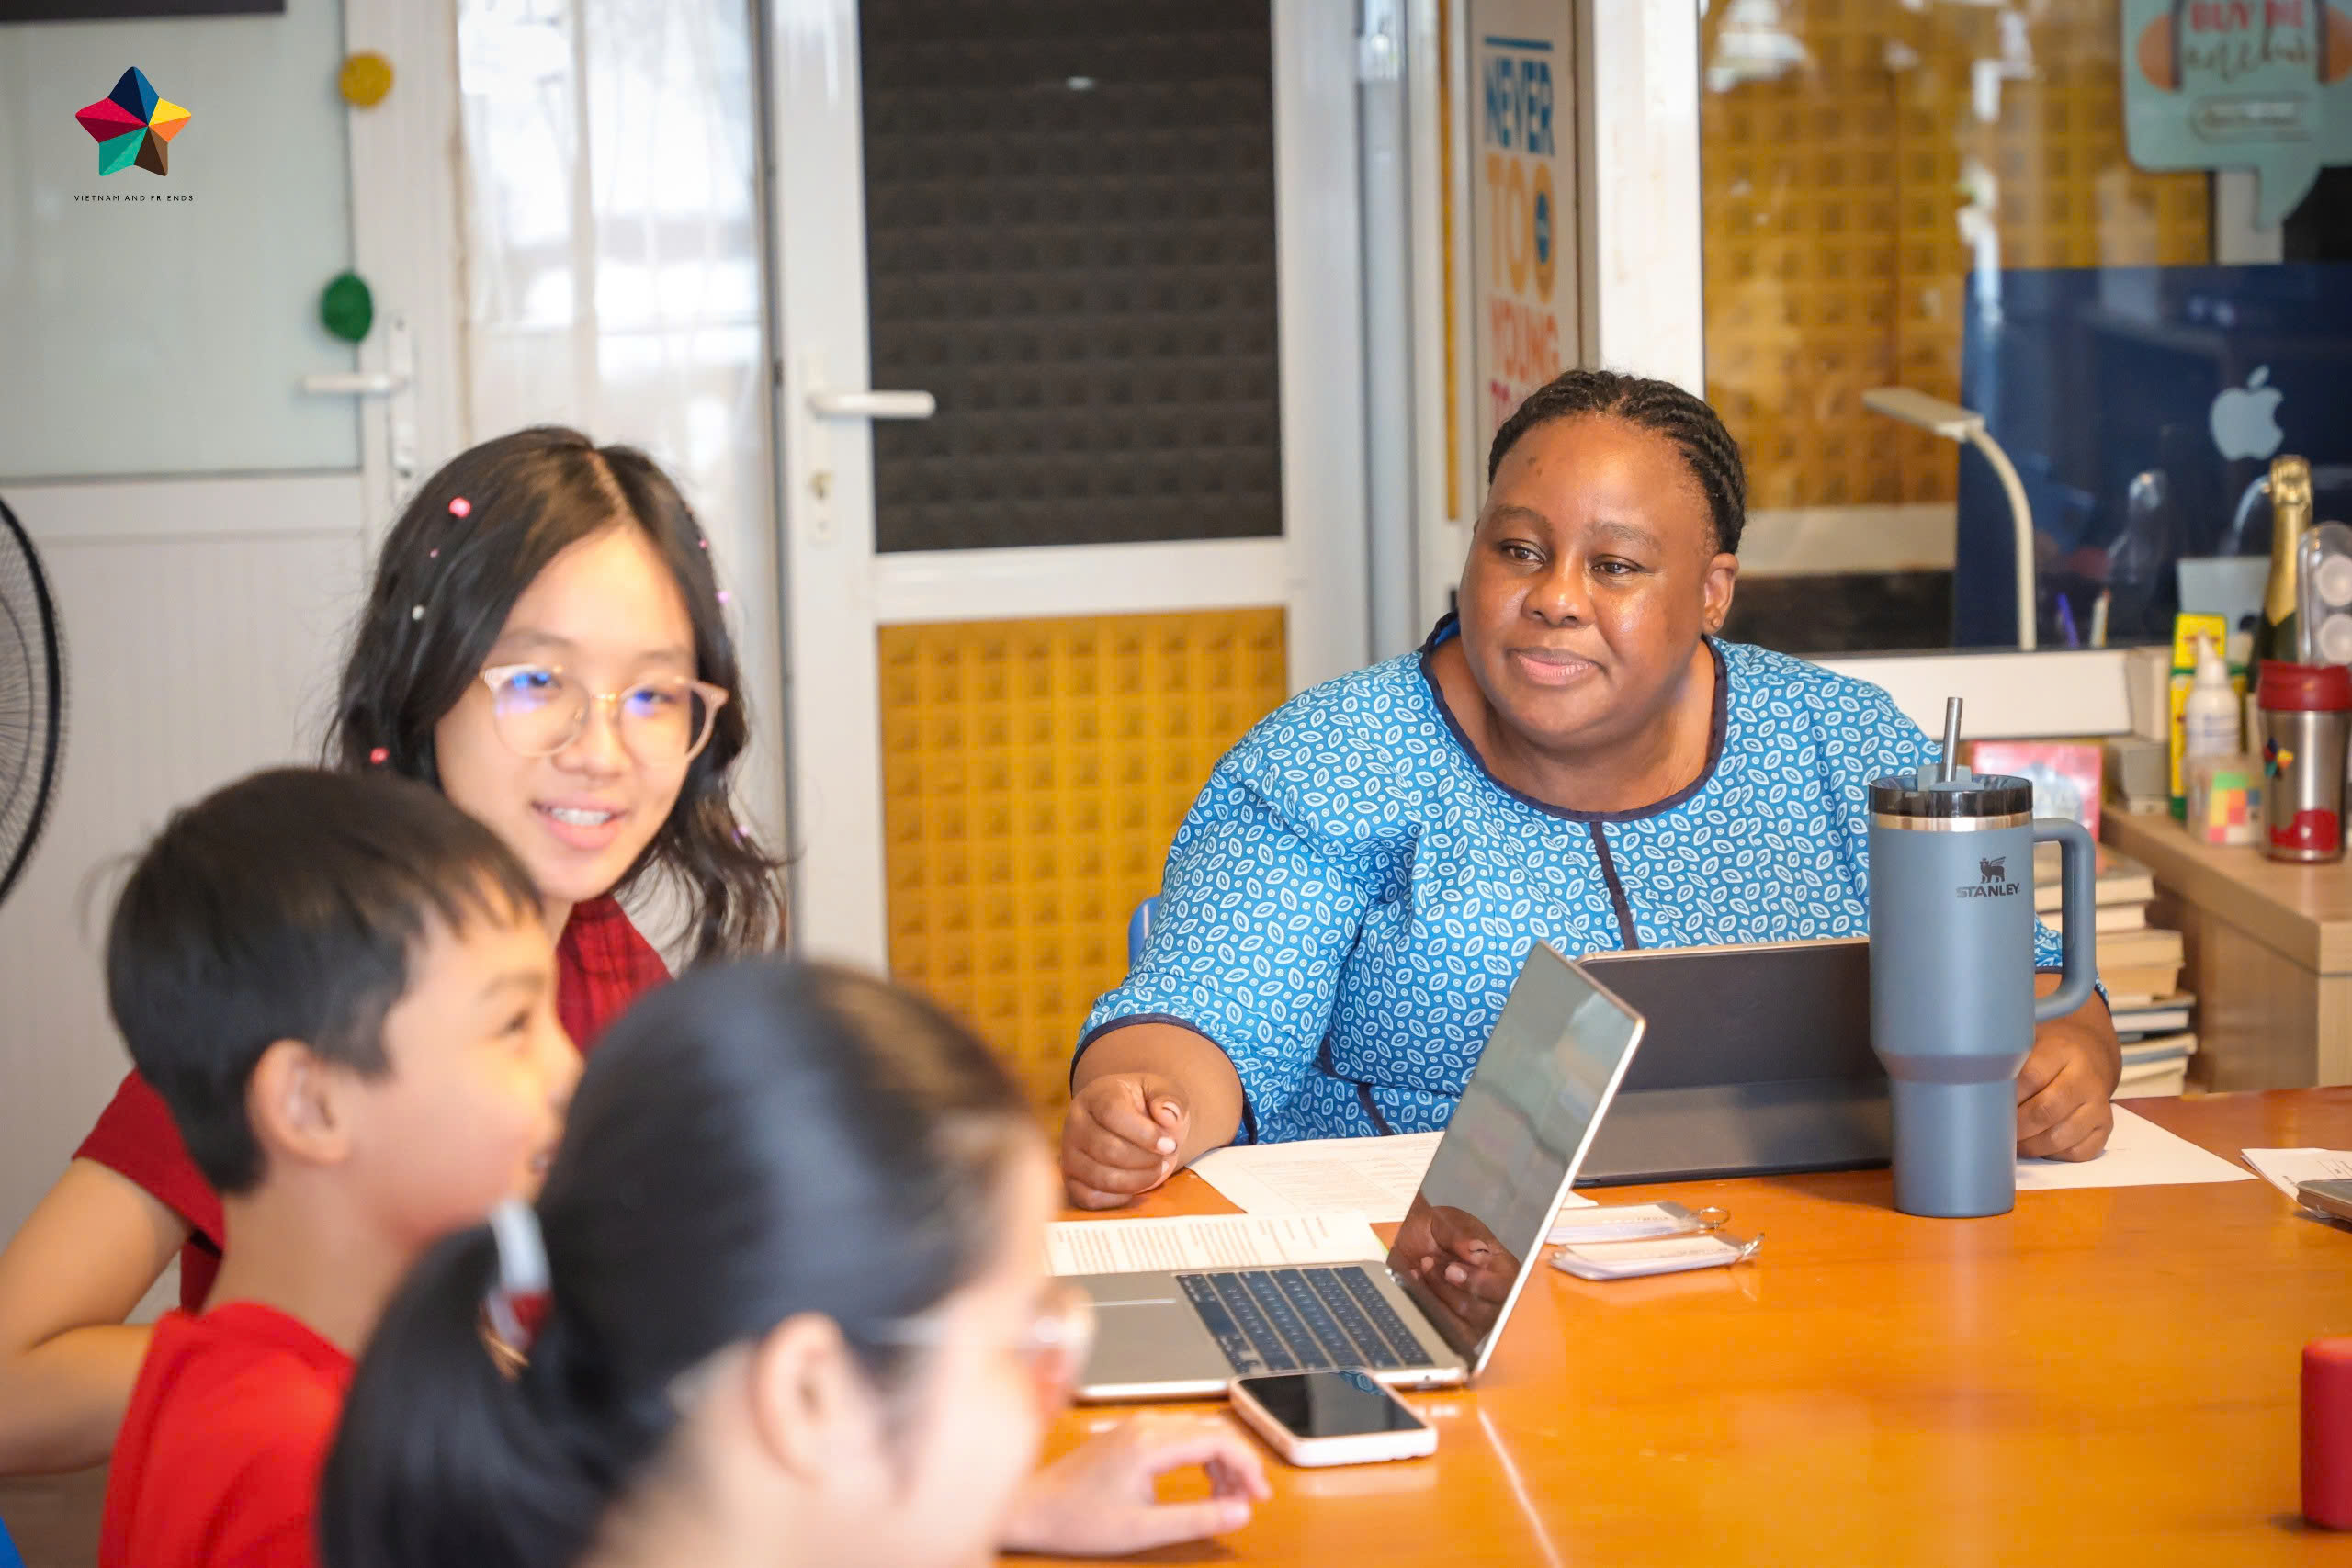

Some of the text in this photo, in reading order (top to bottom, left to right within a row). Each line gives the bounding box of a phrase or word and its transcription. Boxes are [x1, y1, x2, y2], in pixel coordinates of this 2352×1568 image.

[1483, 58, 1555, 156] NEVER
[1486, 152, 1557, 305] TOO
[1490, 299, 1560, 384] YOUNG
[1956, 883, 2020, 898] STANLEY
